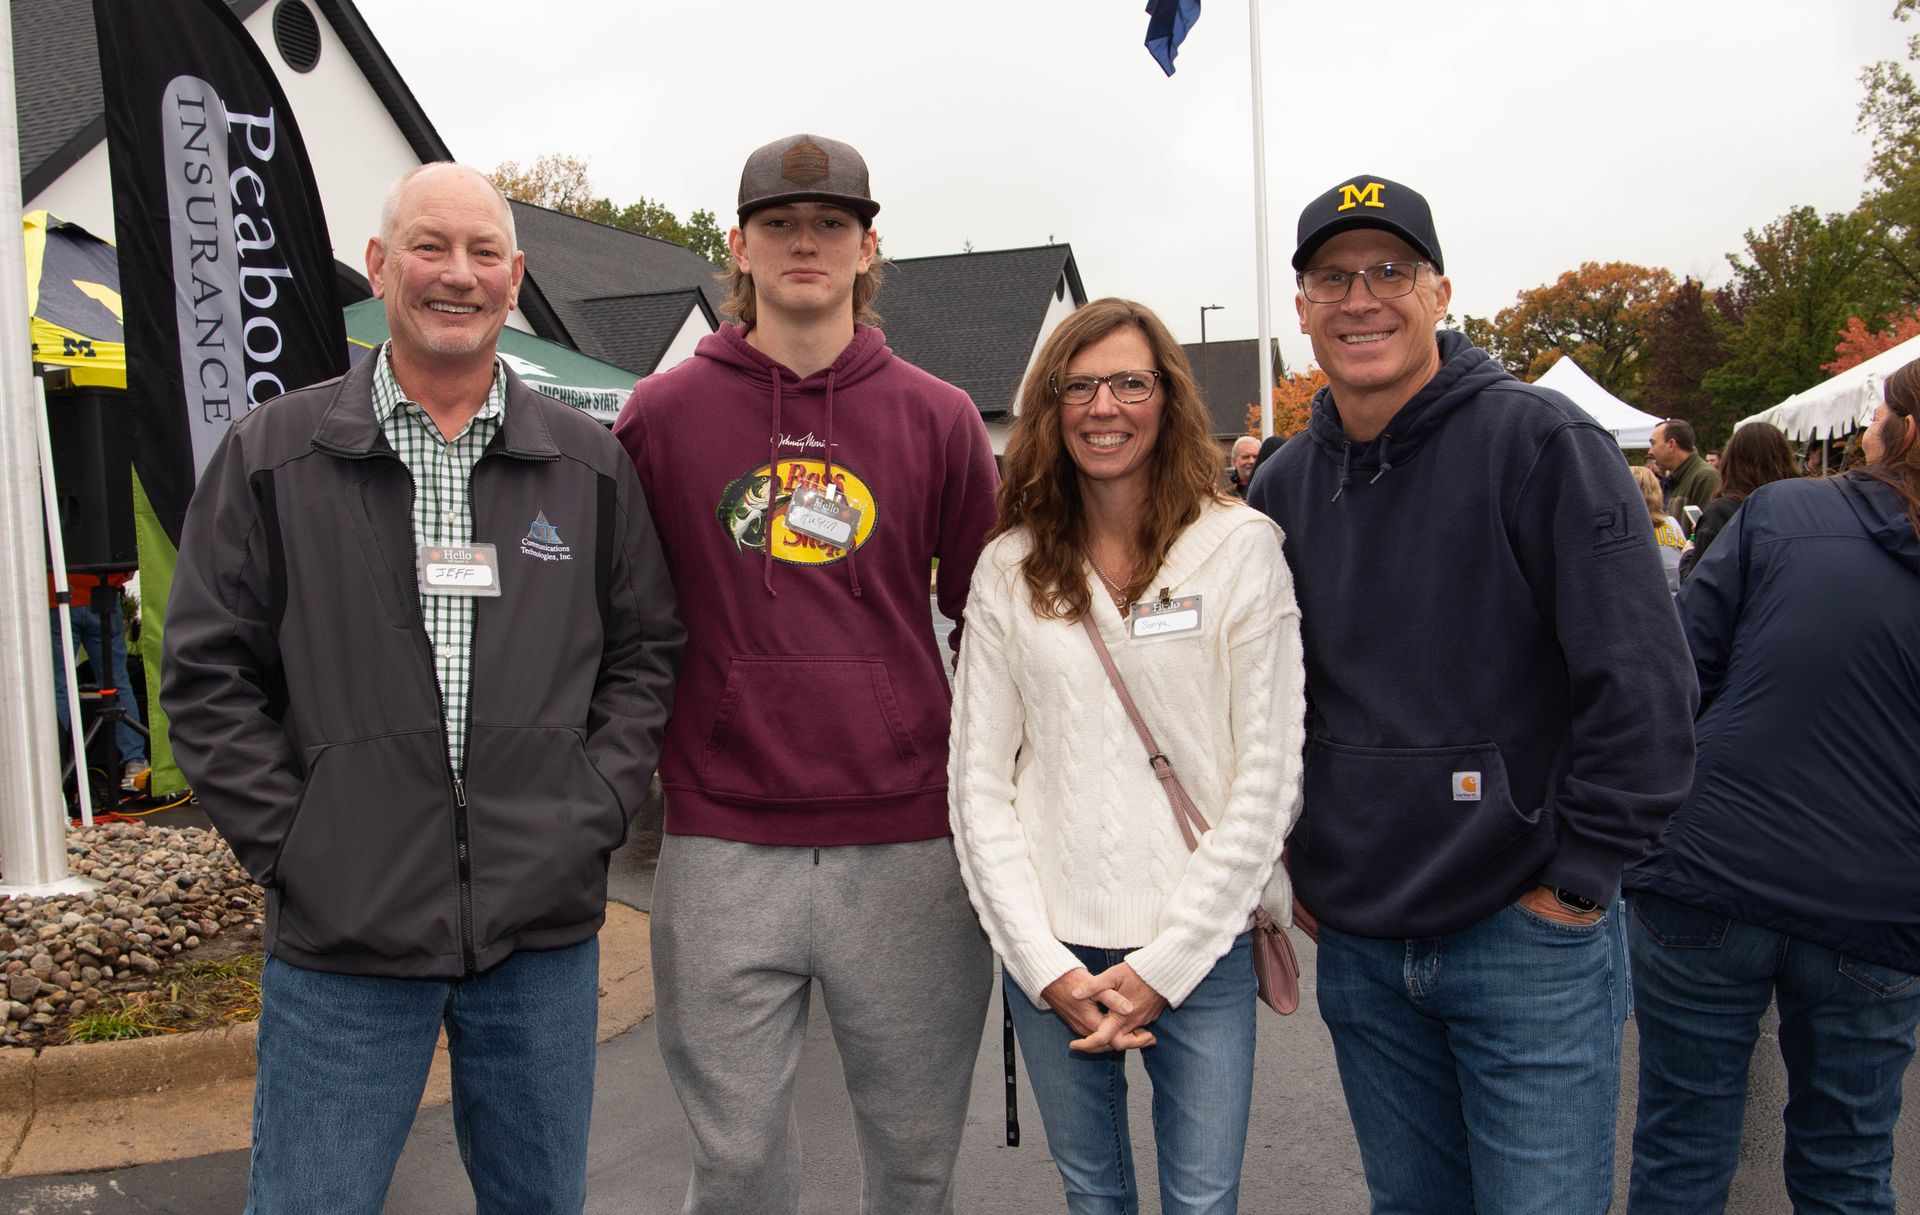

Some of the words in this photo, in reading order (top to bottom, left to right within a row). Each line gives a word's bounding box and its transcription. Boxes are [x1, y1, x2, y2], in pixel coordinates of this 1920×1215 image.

[1337, 182, 1385, 212] M
[176, 93, 232, 425] INSURANCE
[62, 336, 97, 357] M
[593, 392, 620, 412] STATE
[521, 537, 570, 552] Communications
[443, 549, 473, 560] Hello
[520, 546, 559, 561] Technologies,
[559, 553, 573, 561] Inc.
[435, 567, 475, 579] JEFF
